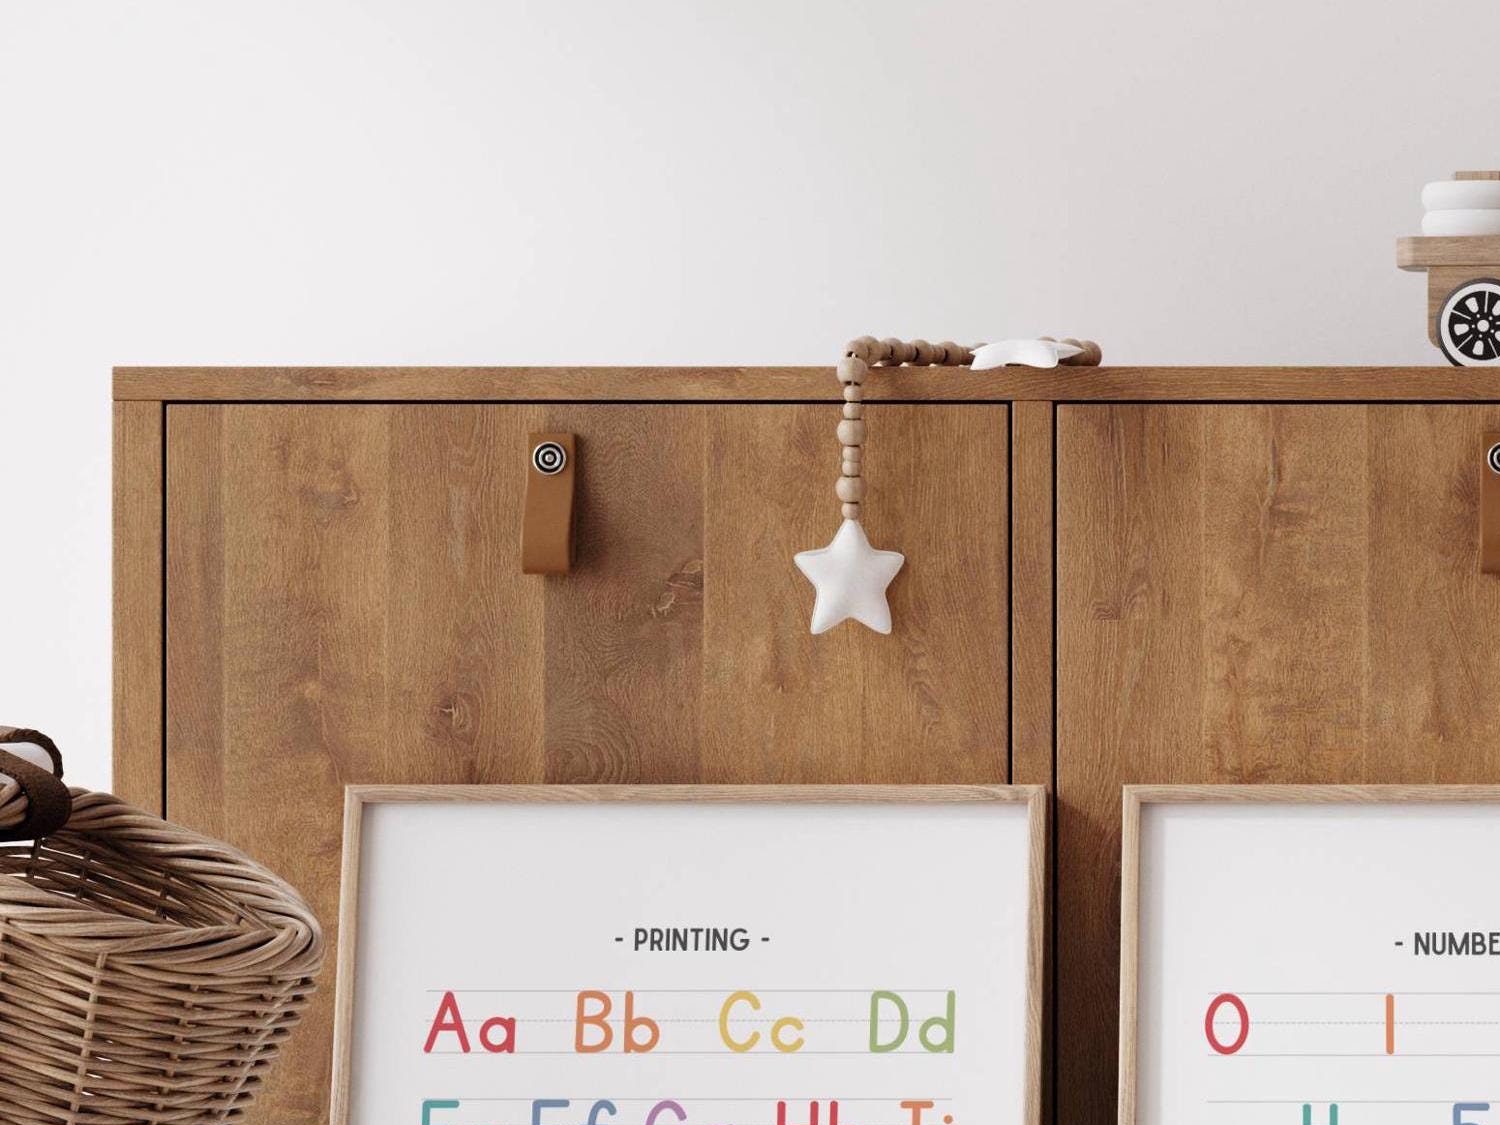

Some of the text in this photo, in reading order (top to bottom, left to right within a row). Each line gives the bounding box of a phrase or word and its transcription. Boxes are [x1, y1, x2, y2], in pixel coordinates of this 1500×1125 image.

[634, 927, 750, 952] PRINTING
[422, 987, 957, 1056] Aa Bb Cc Dd
[1203, 991, 1251, 1057] 0
